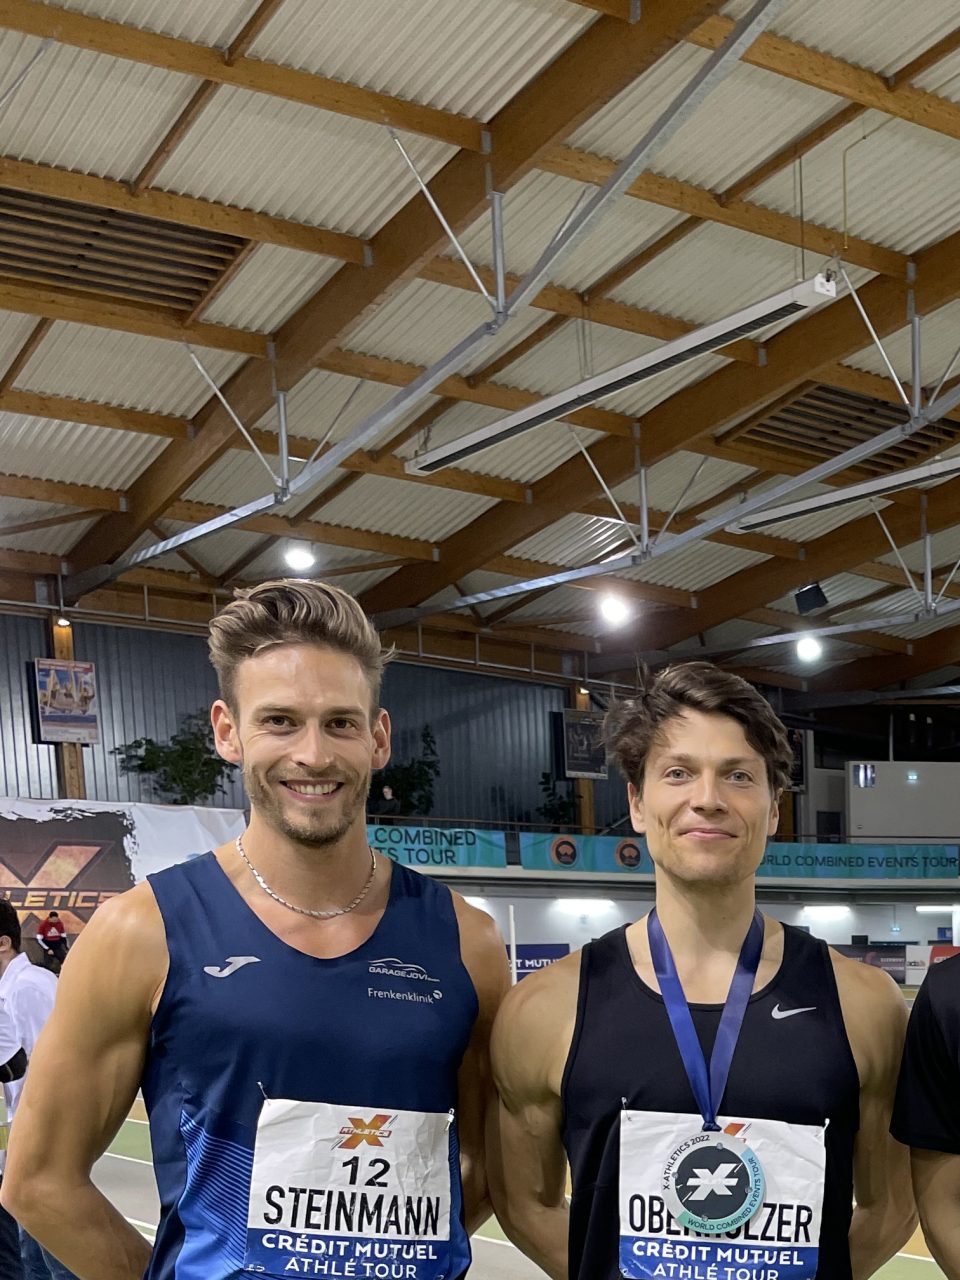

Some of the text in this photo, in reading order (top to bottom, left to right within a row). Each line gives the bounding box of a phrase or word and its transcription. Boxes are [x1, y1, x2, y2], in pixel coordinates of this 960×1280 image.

[374, 827, 476, 846] COMBINED
[403, 848, 457, 865] TOUR
[794, 855, 865, 868] COMBINED
[868, 856, 918, 868] EVENTS
[922, 856, 958, 868] TOUR
[367, 987, 434, 1004] Frenkenklinik
[691, 1134, 710, 1145] 2022
[342, 1155, 391, 1188] 12
[687, 1156, 761, 1231] WORLD COMBINED EVENTS TOUR
[263, 1185, 441, 1236] STEINMANN
[261, 1233, 438, 1260] CRÉDIT MUTUEL
[632, 1240, 804, 1265] CRÉDIT MUTUEL
[284, 1256, 417, 1279] ATHLÉ TOUR
[653, 1262, 718, 1280] ATHLÉ
